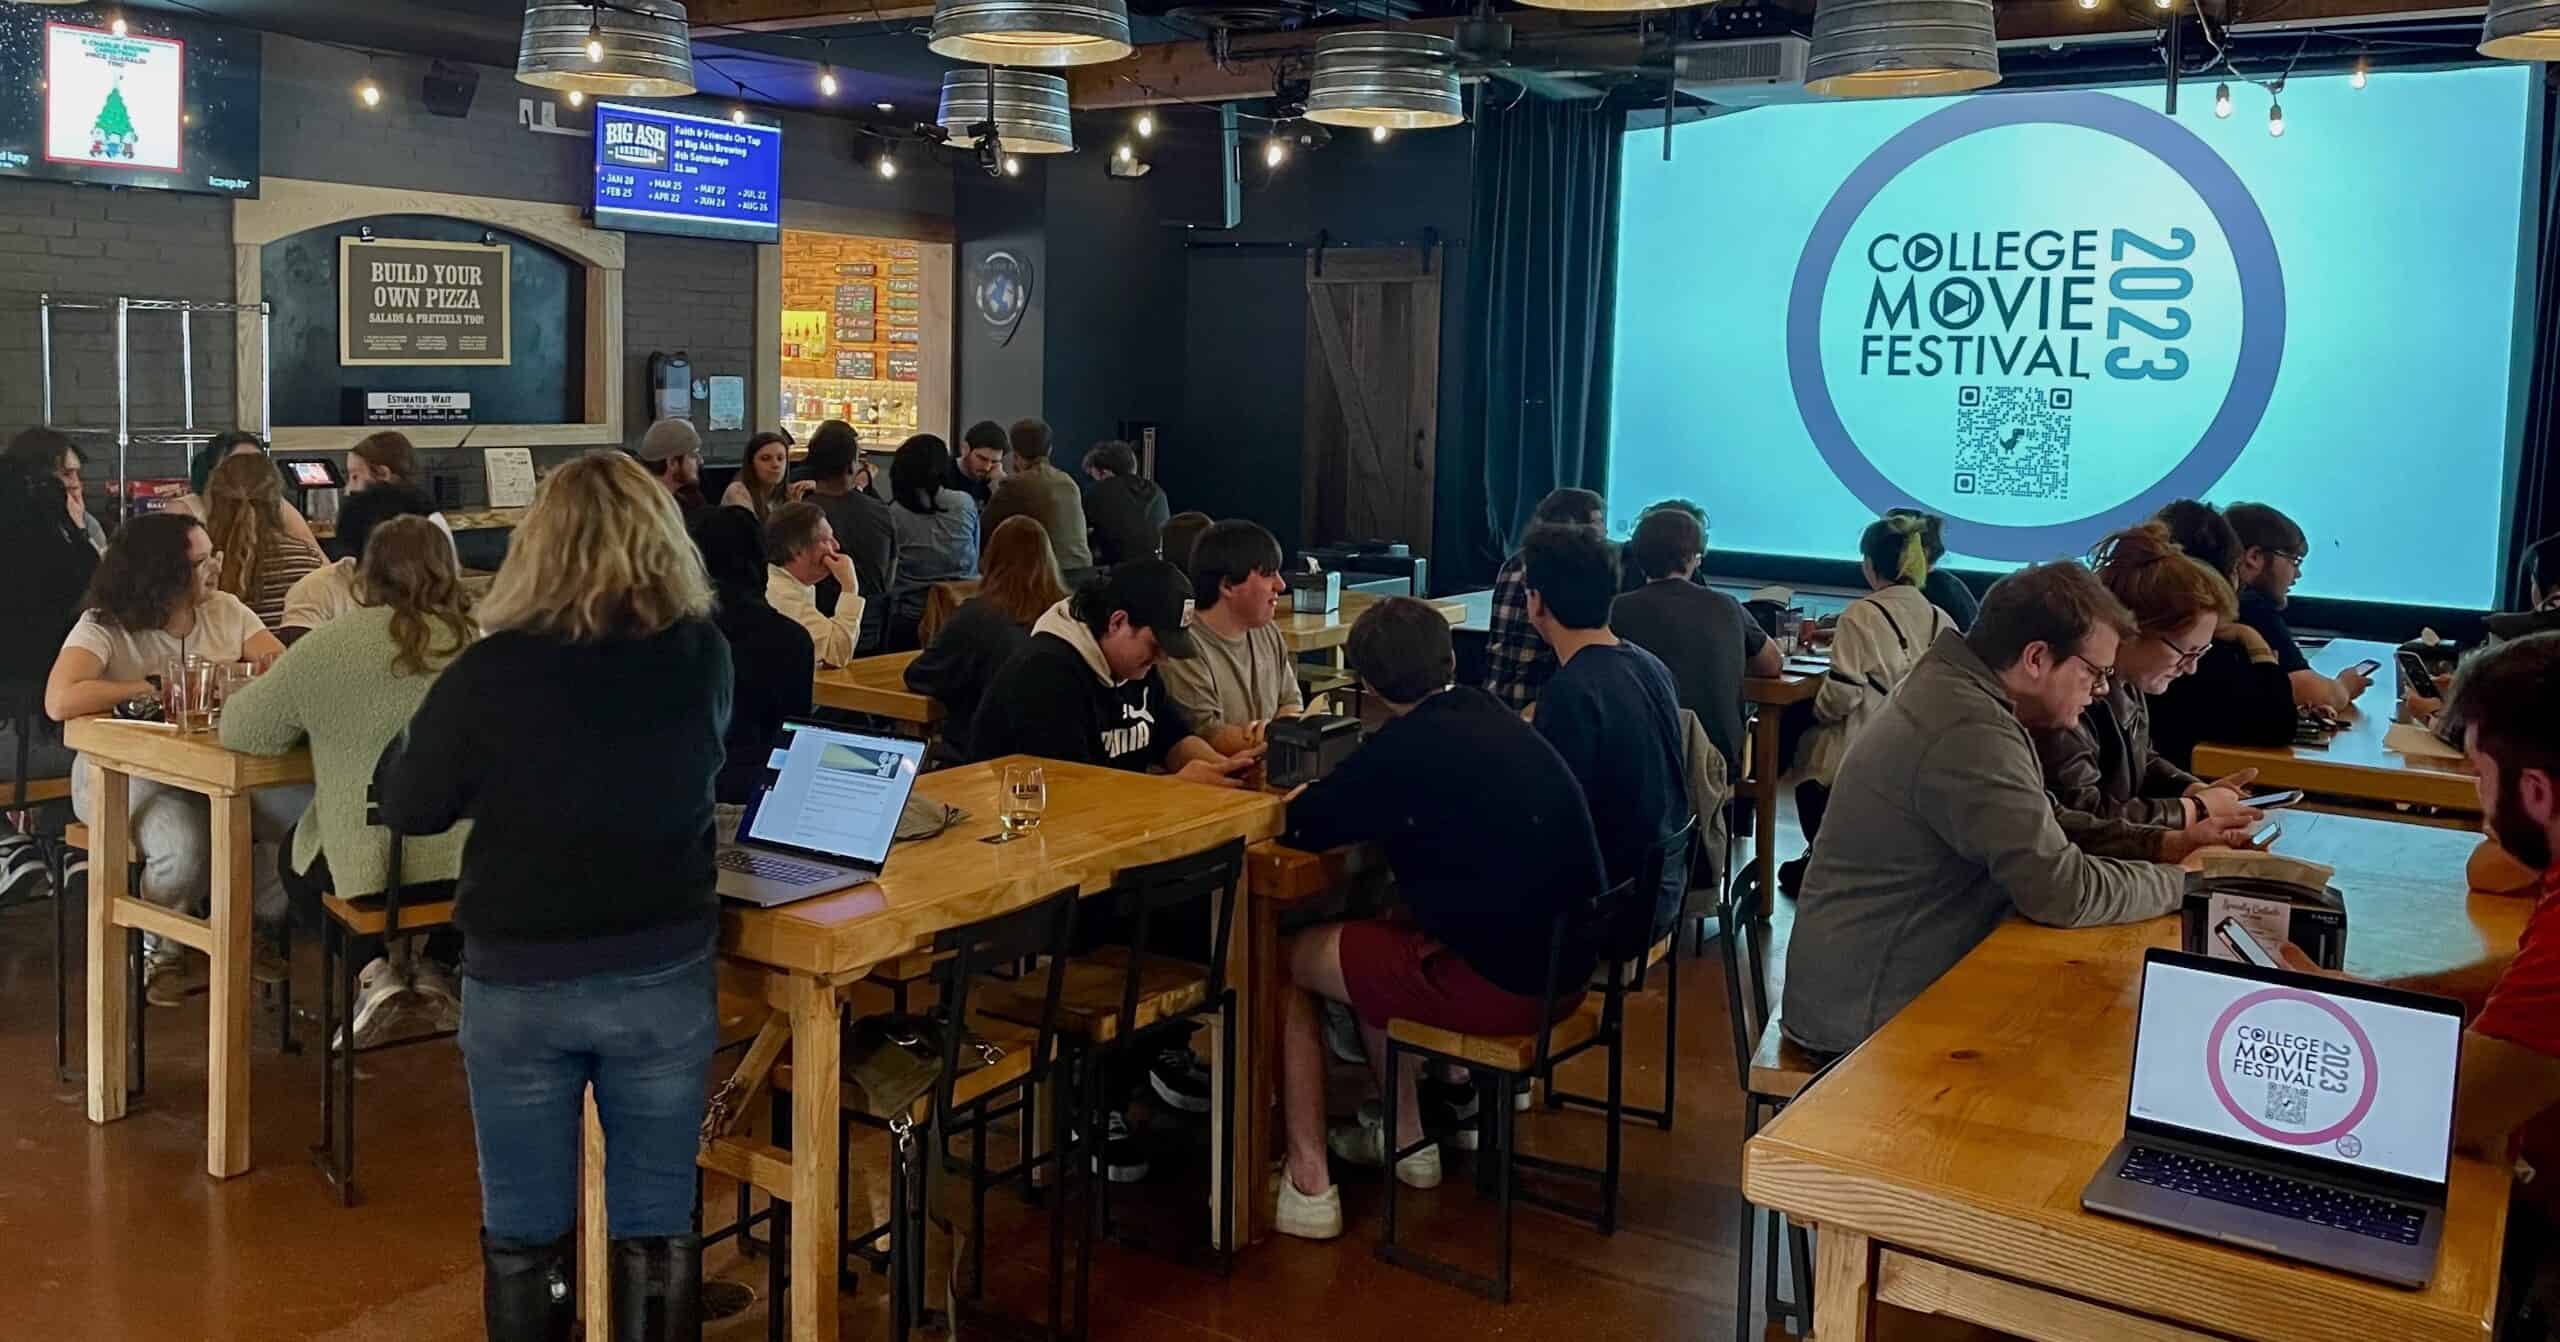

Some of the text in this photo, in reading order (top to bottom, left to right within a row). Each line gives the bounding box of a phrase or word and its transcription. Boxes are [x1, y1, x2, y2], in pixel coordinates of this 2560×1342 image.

[606, 122, 667, 153] BIG ASH
[674, 125, 696, 137] Faith
[704, 129, 733, 142] Friends
[734, 134, 746, 144] On
[747, 135, 761, 147] Tap
[674, 140, 747, 158] at Big Ash Brewing
[674, 150, 729, 168] 4th Saturdays
[606, 174, 623, 184] JAN
[654, 179, 682, 191] MAR 25
[606, 186, 632, 198] FEB 25
[654, 191, 680, 203] APR 22
[700, 184, 726, 195] MAY 27
[743, 189, 757, 199] JUL
[700, 196, 716, 207] JUN
[743, 201, 759, 211] AUG
[1867, 229, 2098, 273] COLLEGE
[371, 262, 483, 286] BUILD YOUR
[374, 286, 481, 309] OWN PIZZA
[1863, 274, 2096, 334] MOVIE
[2104, 227, 2196, 381] 2023
[369, 312, 405, 324] SALADS
[416, 313, 462, 325] PRETZELS
[1860, 334, 2090, 380] FESTIVAL
[387, 394, 452, 404] ESTIMATED WAIT
[2238, 1025, 2320, 1053] COLLEGE
[2236, 1040, 2318, 1073] MOVIE
[2233, 1058, 2315, 1089] FESTIVAL
[2319, 1040, 2352, 1094] 2023
